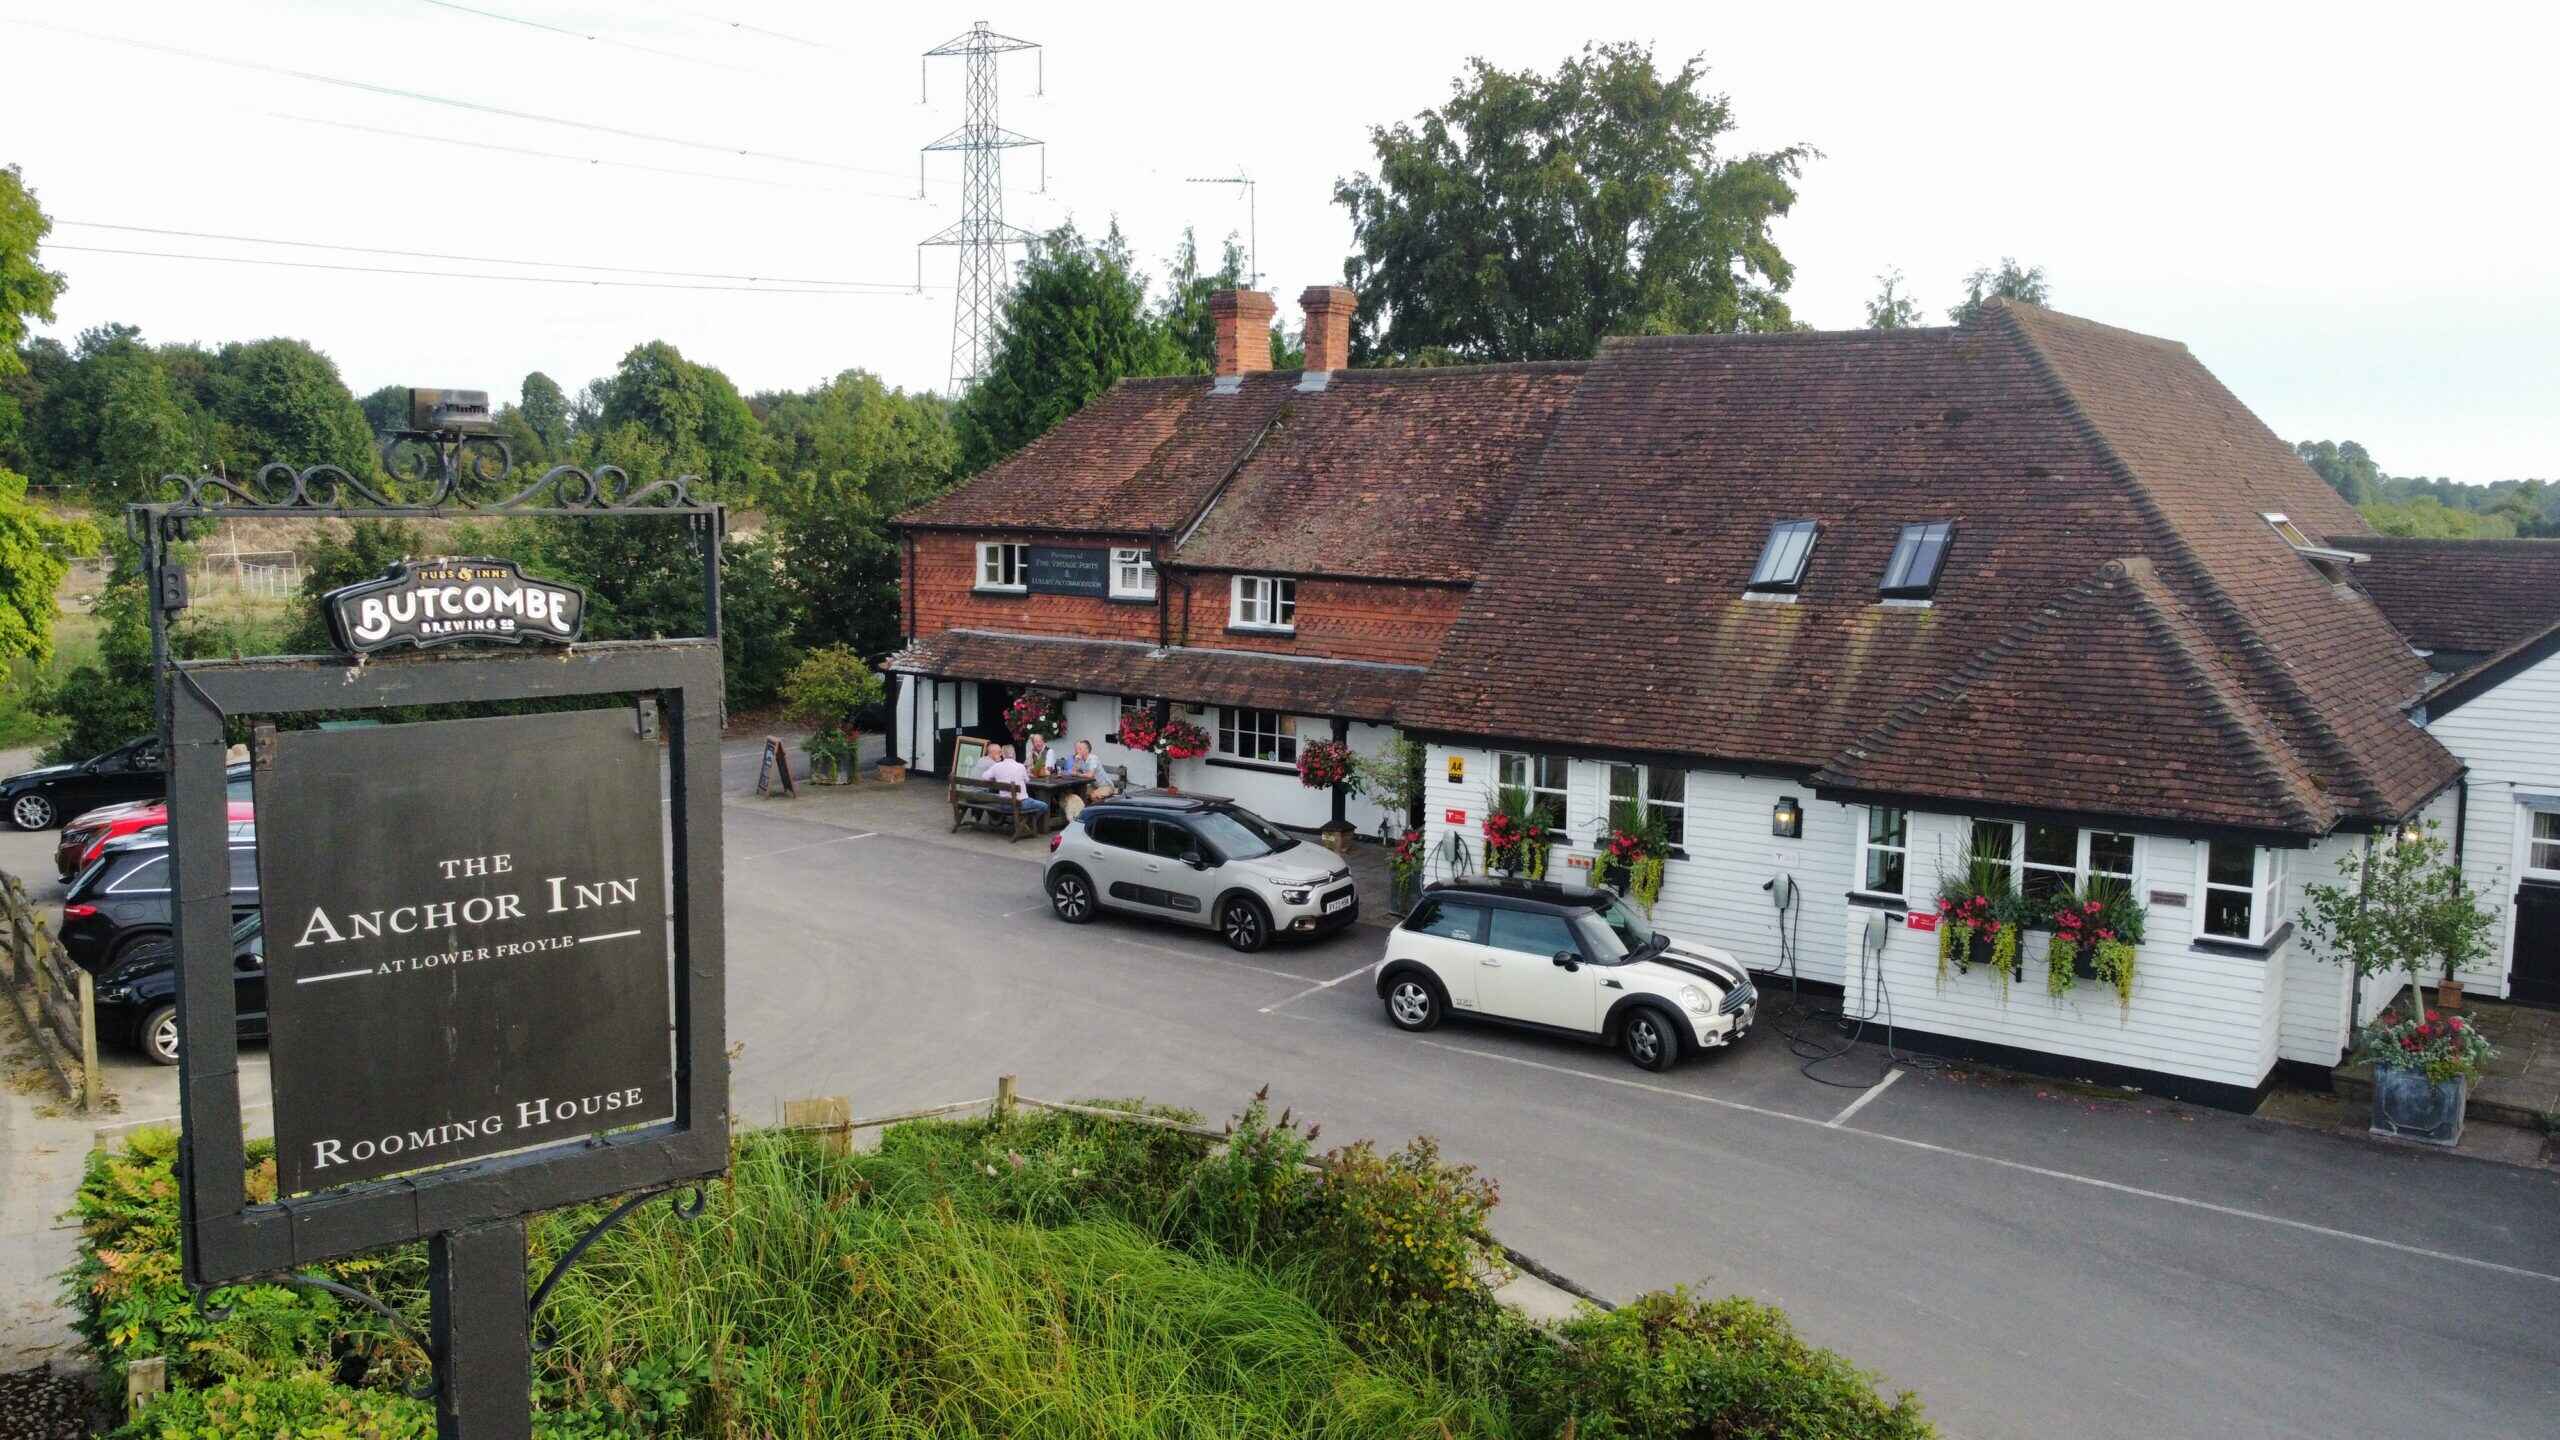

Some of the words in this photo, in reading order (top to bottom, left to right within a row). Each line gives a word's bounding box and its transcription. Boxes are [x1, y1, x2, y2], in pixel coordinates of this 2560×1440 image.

[419, 569, 455, 580] PUBS
[457, 567, 473, 582] &
[476, 569, 508, 579] INNS
[354, 585, 571, 640] BUTCOMBE
[420, 619, 497, 634] BREWING
[439, 853, 513, 880] THE
[294, 893, 527, 948] ANCHOR
[545, 876, 640, 914] INN
[377, 959, 405, 975] AT
[411, 947, 490, 971] LOWER
[495, 935, 575, 958] FROYLE
[312, 1114, 504, 1169] ROOMING
[516, 1087, 644, 1129] HOUSE
